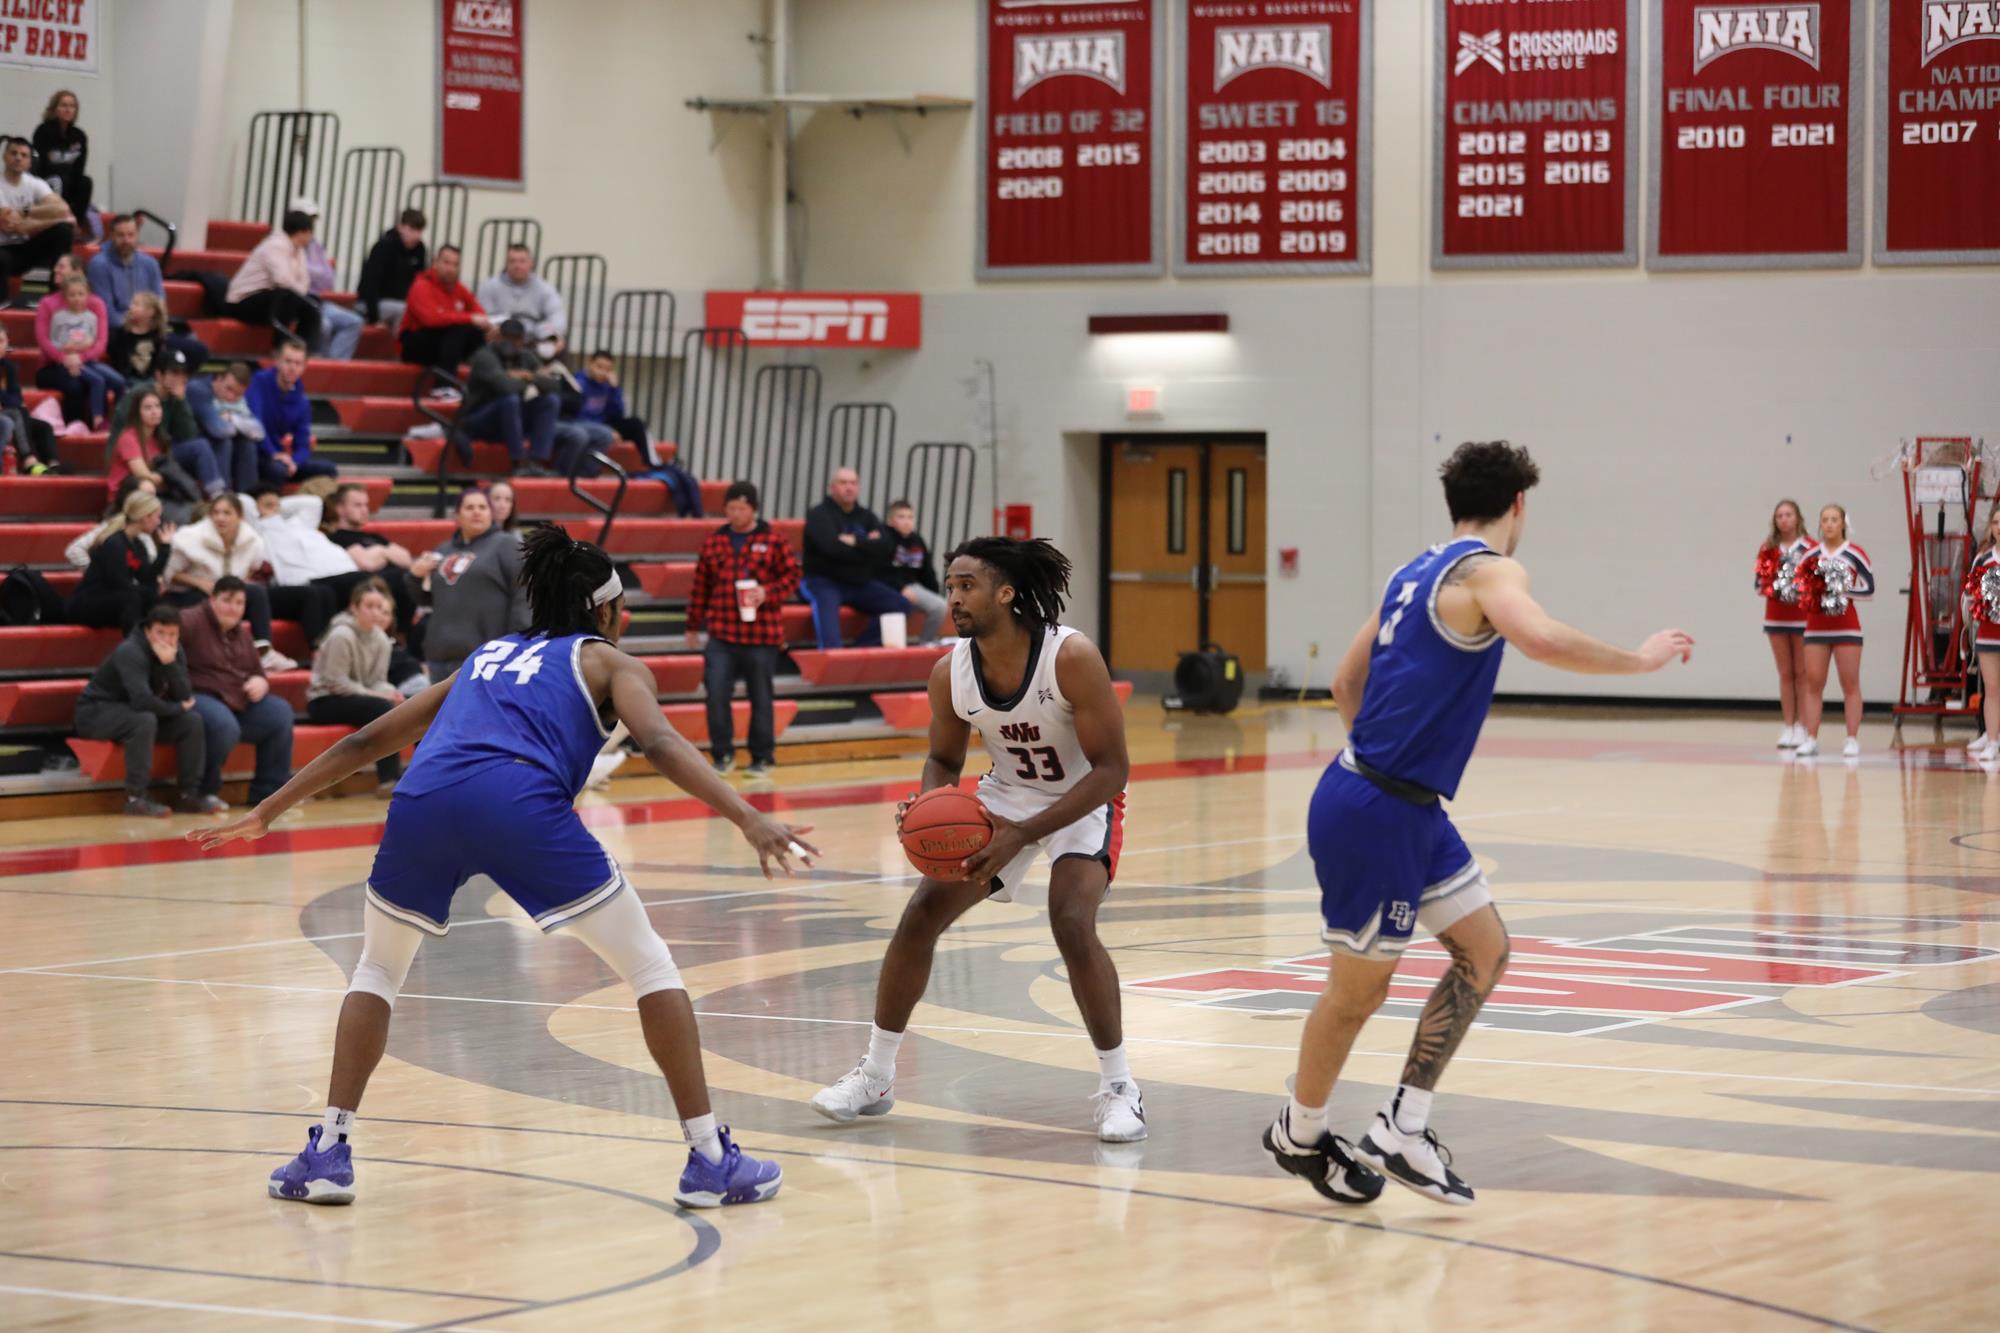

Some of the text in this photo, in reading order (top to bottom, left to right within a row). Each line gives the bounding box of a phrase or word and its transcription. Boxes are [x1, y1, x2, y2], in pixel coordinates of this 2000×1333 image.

[25, 26, 88, 61] BAND
[1508, 28, 1618, 58] CROSSROADS
[1699, 9, 1814, 61] NAIA
[1018, 37, 1119, 88] NAIA
[1219, 31, 1325, 79] NAIA
[1509, 55, 1586, 71] LEAGUE
[1931, 65, 2000, 85] NATIO
[1454, 98, 1617, 124] CHAMPIONS
[1668, 84, 1840, 112] FINAL FOUR
[1899, 86, 2000, 113] CHAMP
[995, 107, 1145, 136] FIELD OF 32
[1200, 100, 1347, 129] SWEET 16
[1458, 129, 1610, 155] 2012 2013
[1677, 122, 1835, 149] 2010 2021
[1903, 121, 1977, 145] 2007
[998, 144, 1141, 170] 2008 2015
[1199, 138, 1347, 164] 2003 2004
[1198, 169, 1347, 194] 2006 2009
[1458, 160, 1611, 186] 2015 2016
[998, 178, 1063, 200] 2020
[1197, 200, 1343, 225] 2014 2016
[1458, 194, 1524, 217] 2021
[1197, 230, 1346, 255] 2018 2019
[741, 299, 889, 341] ESPN
[469, 639, 550, 685] 24
[1005, 745, 1066, 782] 33
